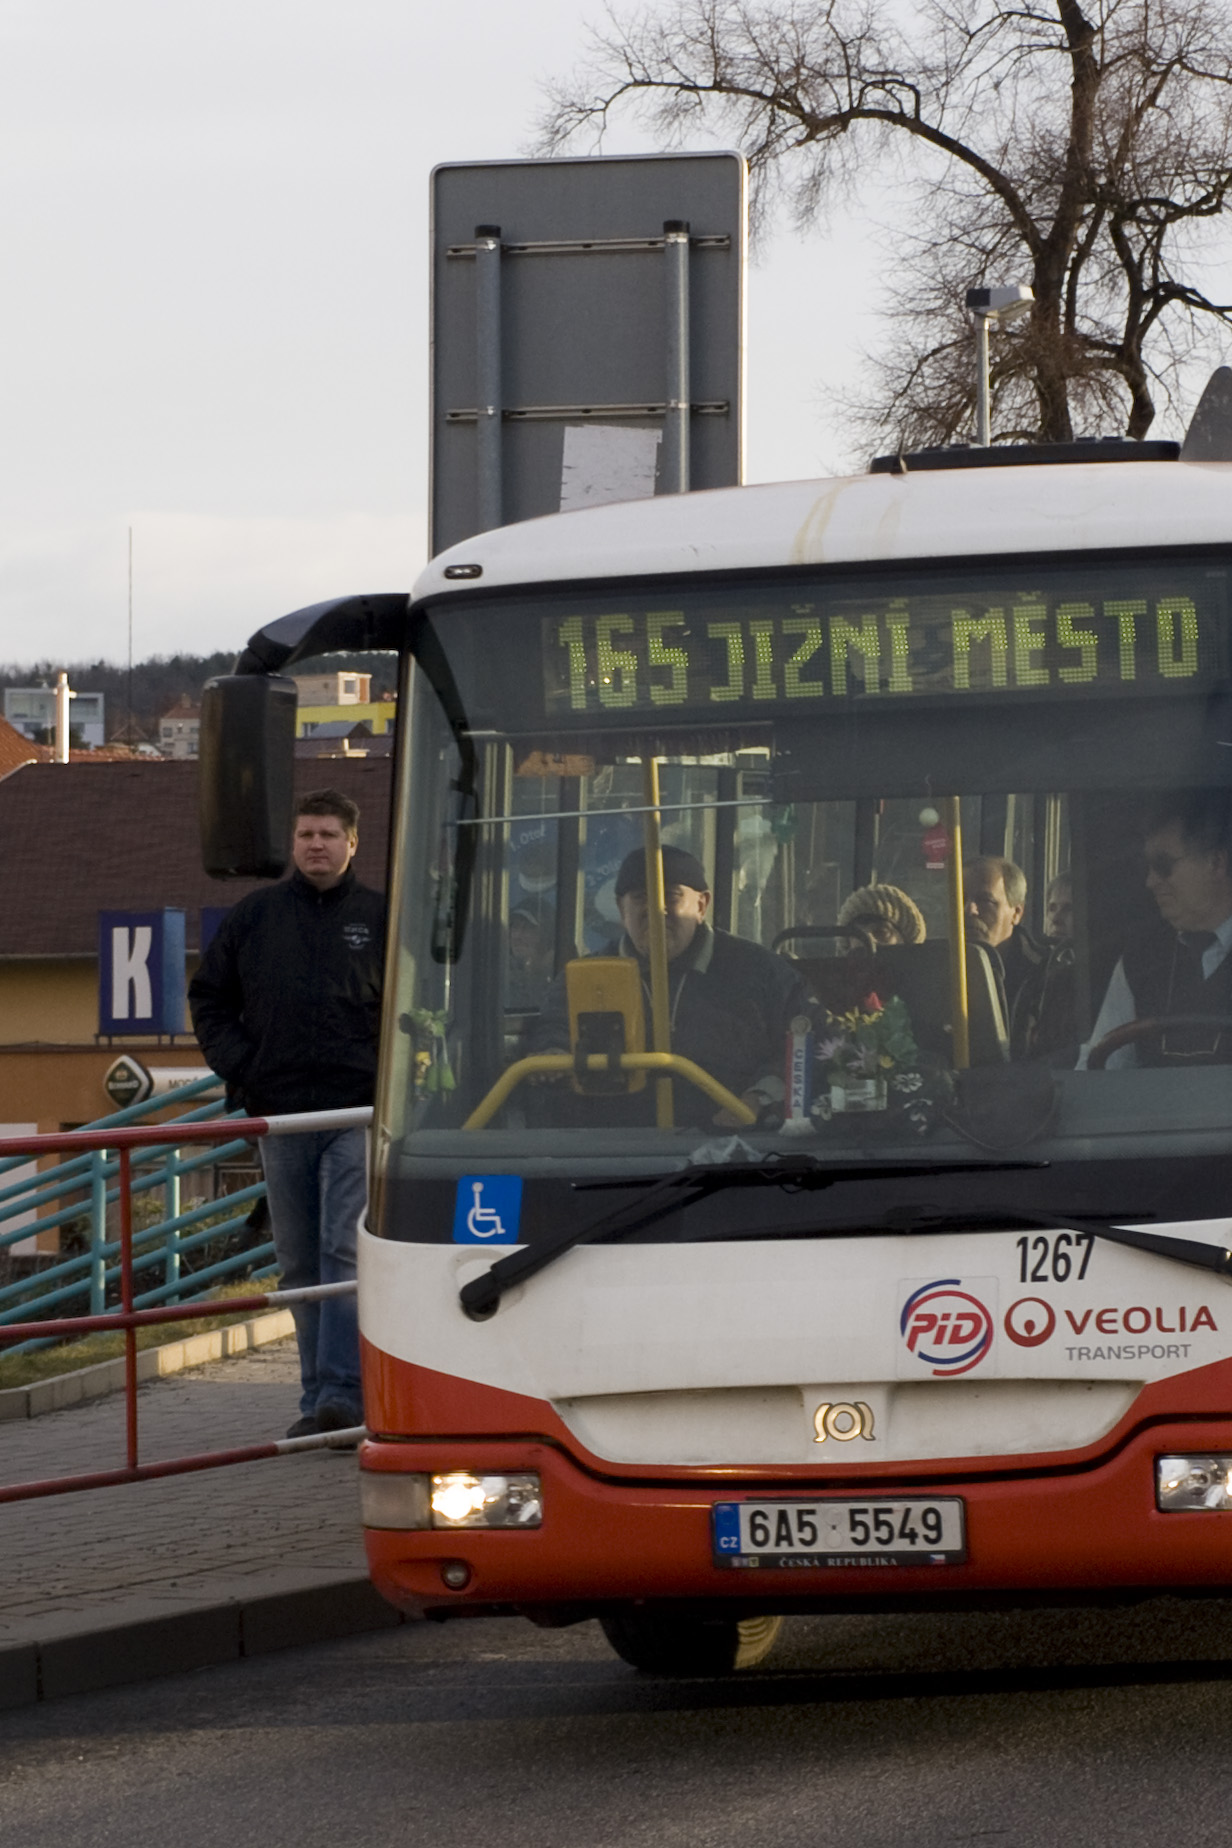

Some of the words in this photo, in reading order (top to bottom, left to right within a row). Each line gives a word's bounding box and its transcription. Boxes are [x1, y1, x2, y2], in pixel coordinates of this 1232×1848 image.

[558, 611, 688, 709] 165
[952, 591, 1199, 688] MĚSTO
[112, 926, 152, 1019] K
[1016, 1232, 1096, 1283] 1267
[1064, 1305, 1218, 1336] VEOLIA
[1065, 1344, 1192, 1362] TRANSPORT
[720, 1536, 738, 1549] CZ
[749, 1509, 819, 1548] 6A5
[848, 1506, 943, 1547] 5549
[827, 1557, 898, 1568] REPUBLIKA
